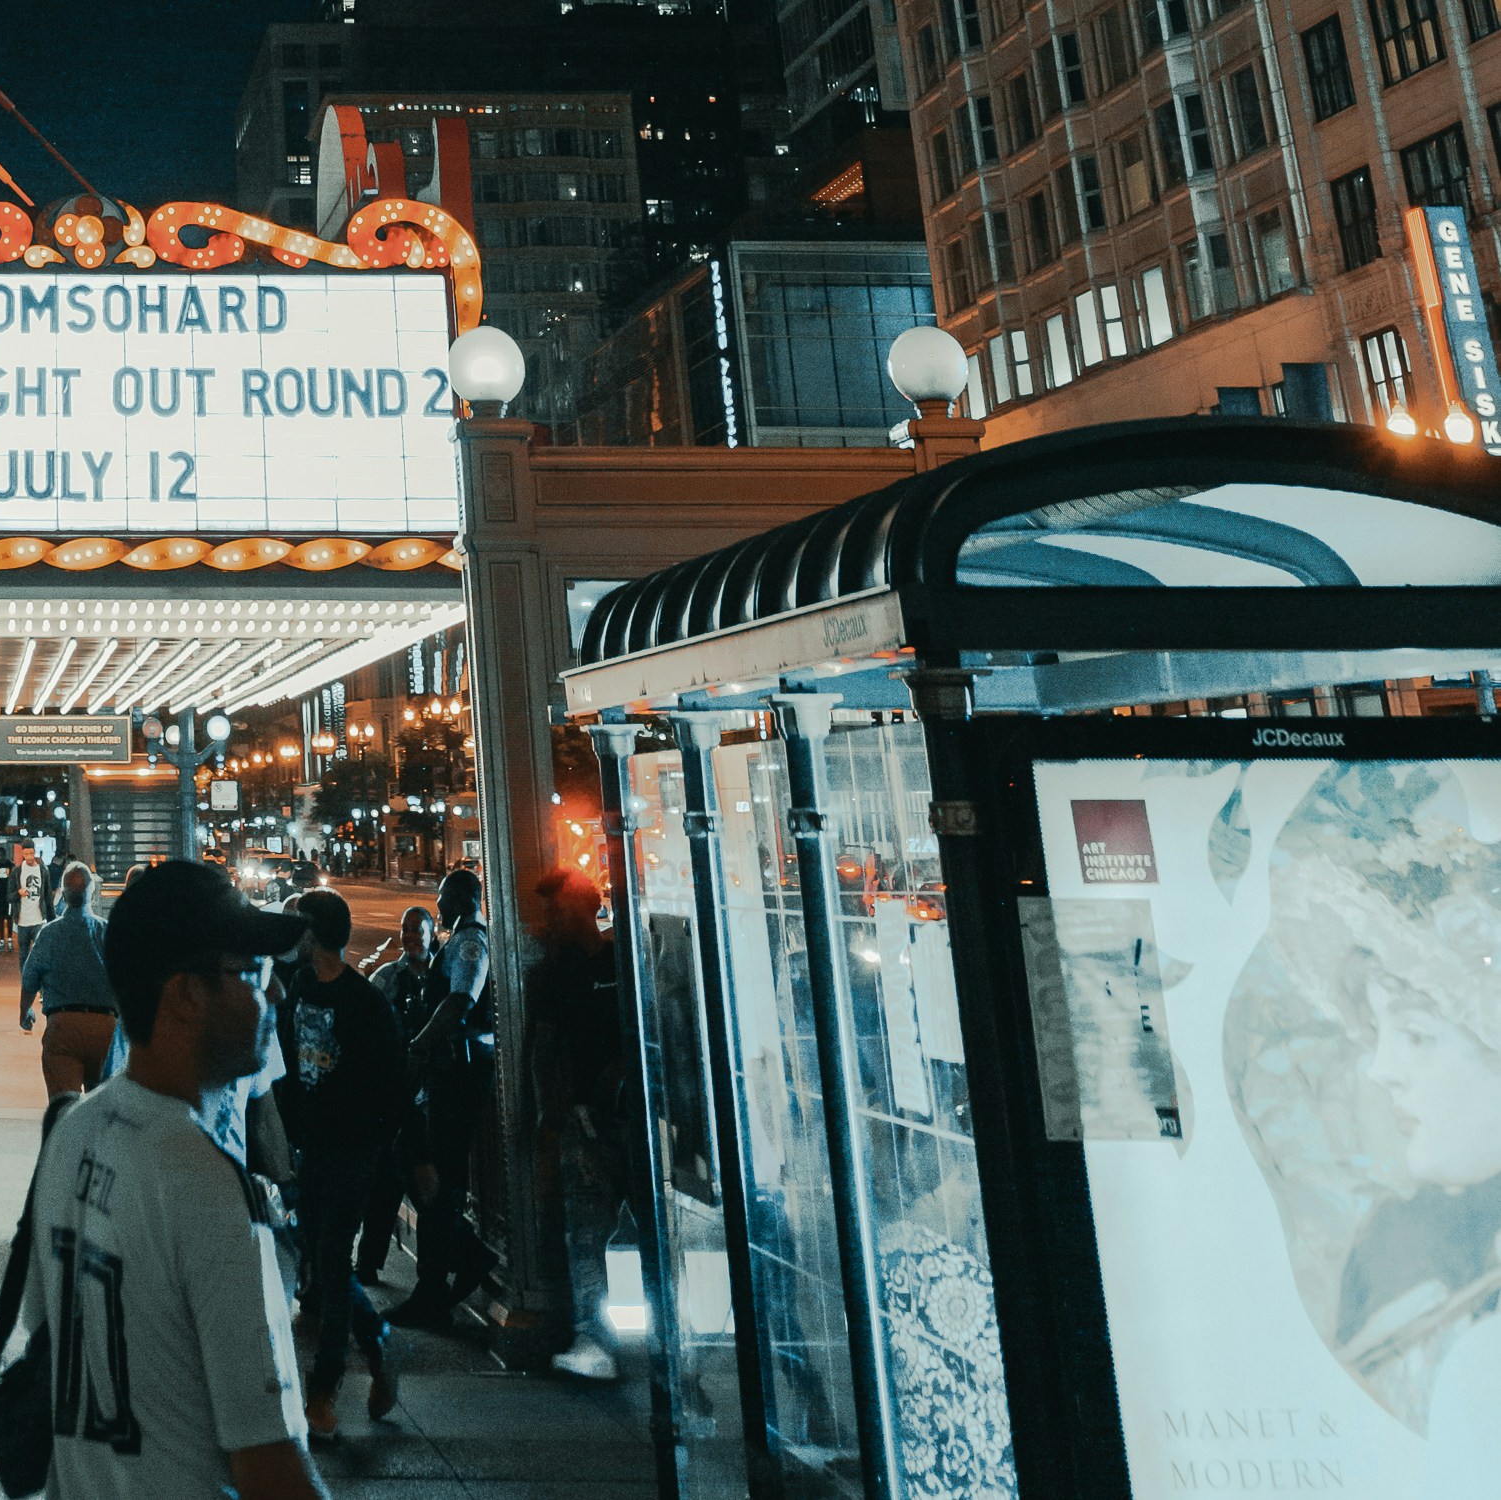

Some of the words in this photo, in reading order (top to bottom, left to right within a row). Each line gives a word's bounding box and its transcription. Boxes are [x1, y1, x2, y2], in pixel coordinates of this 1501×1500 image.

[710, 260, 728, 350] SEVEN
[1437, 220, 1477, 322] GENE
[1464, 340, 1501, 456] SISK
[112, 365, 216, 418] OUT
[241, 366, 408, 419] ROUND
[421, 367, 453, 418] 2
[148, 449, 197, 502] 12
[823, 614, 868, 648] JCDecaux
[7, 736, 23, 744] THE
[23, 736, 50, 744] ICONIC
[51, 736, 86, 744] CHICAGO
[86, 736, 122, 744] THEATRE!
[15, 725, 28, 733] GO
[28, 725, 57, 733] BEHIND
[58, 725, 72, 733] THE
[73, 725, 102, 733] SCENES
[103, 725, 114, 733] OF
[1252, 728, 1346, 746] JCDecaux
[1082, 842, 1106, 854] ART
[1085, 867, 1147, 880] CHICAGO
[1162, 1408, 1300, 1439] MANET
[1318, 1411, 1339, 1439] &
[1169, 1459, 1346, 1490] MODERN
